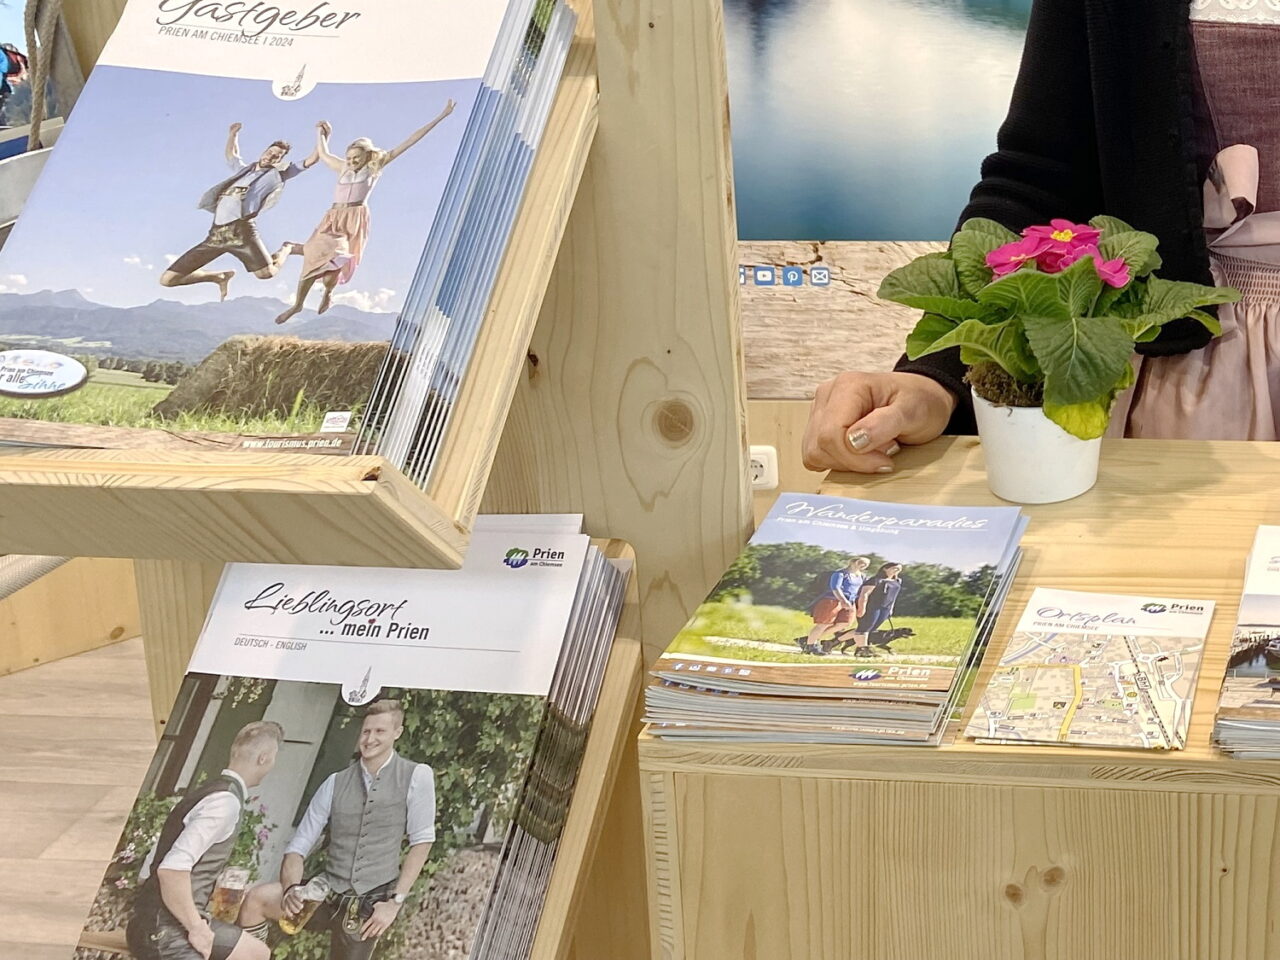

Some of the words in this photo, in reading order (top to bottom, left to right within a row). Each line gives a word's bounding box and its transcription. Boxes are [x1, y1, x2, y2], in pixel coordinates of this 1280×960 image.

[158, 25, 191, 38] PRIEN
[190, 28, 208, 40] AM
[210, 31, 260, 46] CHIEMSEE
[269, 36, 295, 47] 2024
[5, 372, 26, 384] alle
[241, 437, 343, 450] www.tourismus.prien.de
[784, 501, 989, 530] Wanderparadies
[532, 547, 565, 559] Prien
[243, 581, 408, 626] Lieblingsort
[1170, 602, 1204, 611] Prien
[1035, 606, 1137, 626] Ortsplan
[341, 620, 382, 638] mein
[386, 622, 430, 641] Prien
[234, 636, 269, 649] DEUTSCH
[275, 640, 308, 651] ENGLISH
[887, 666, 932, 677] Prien
